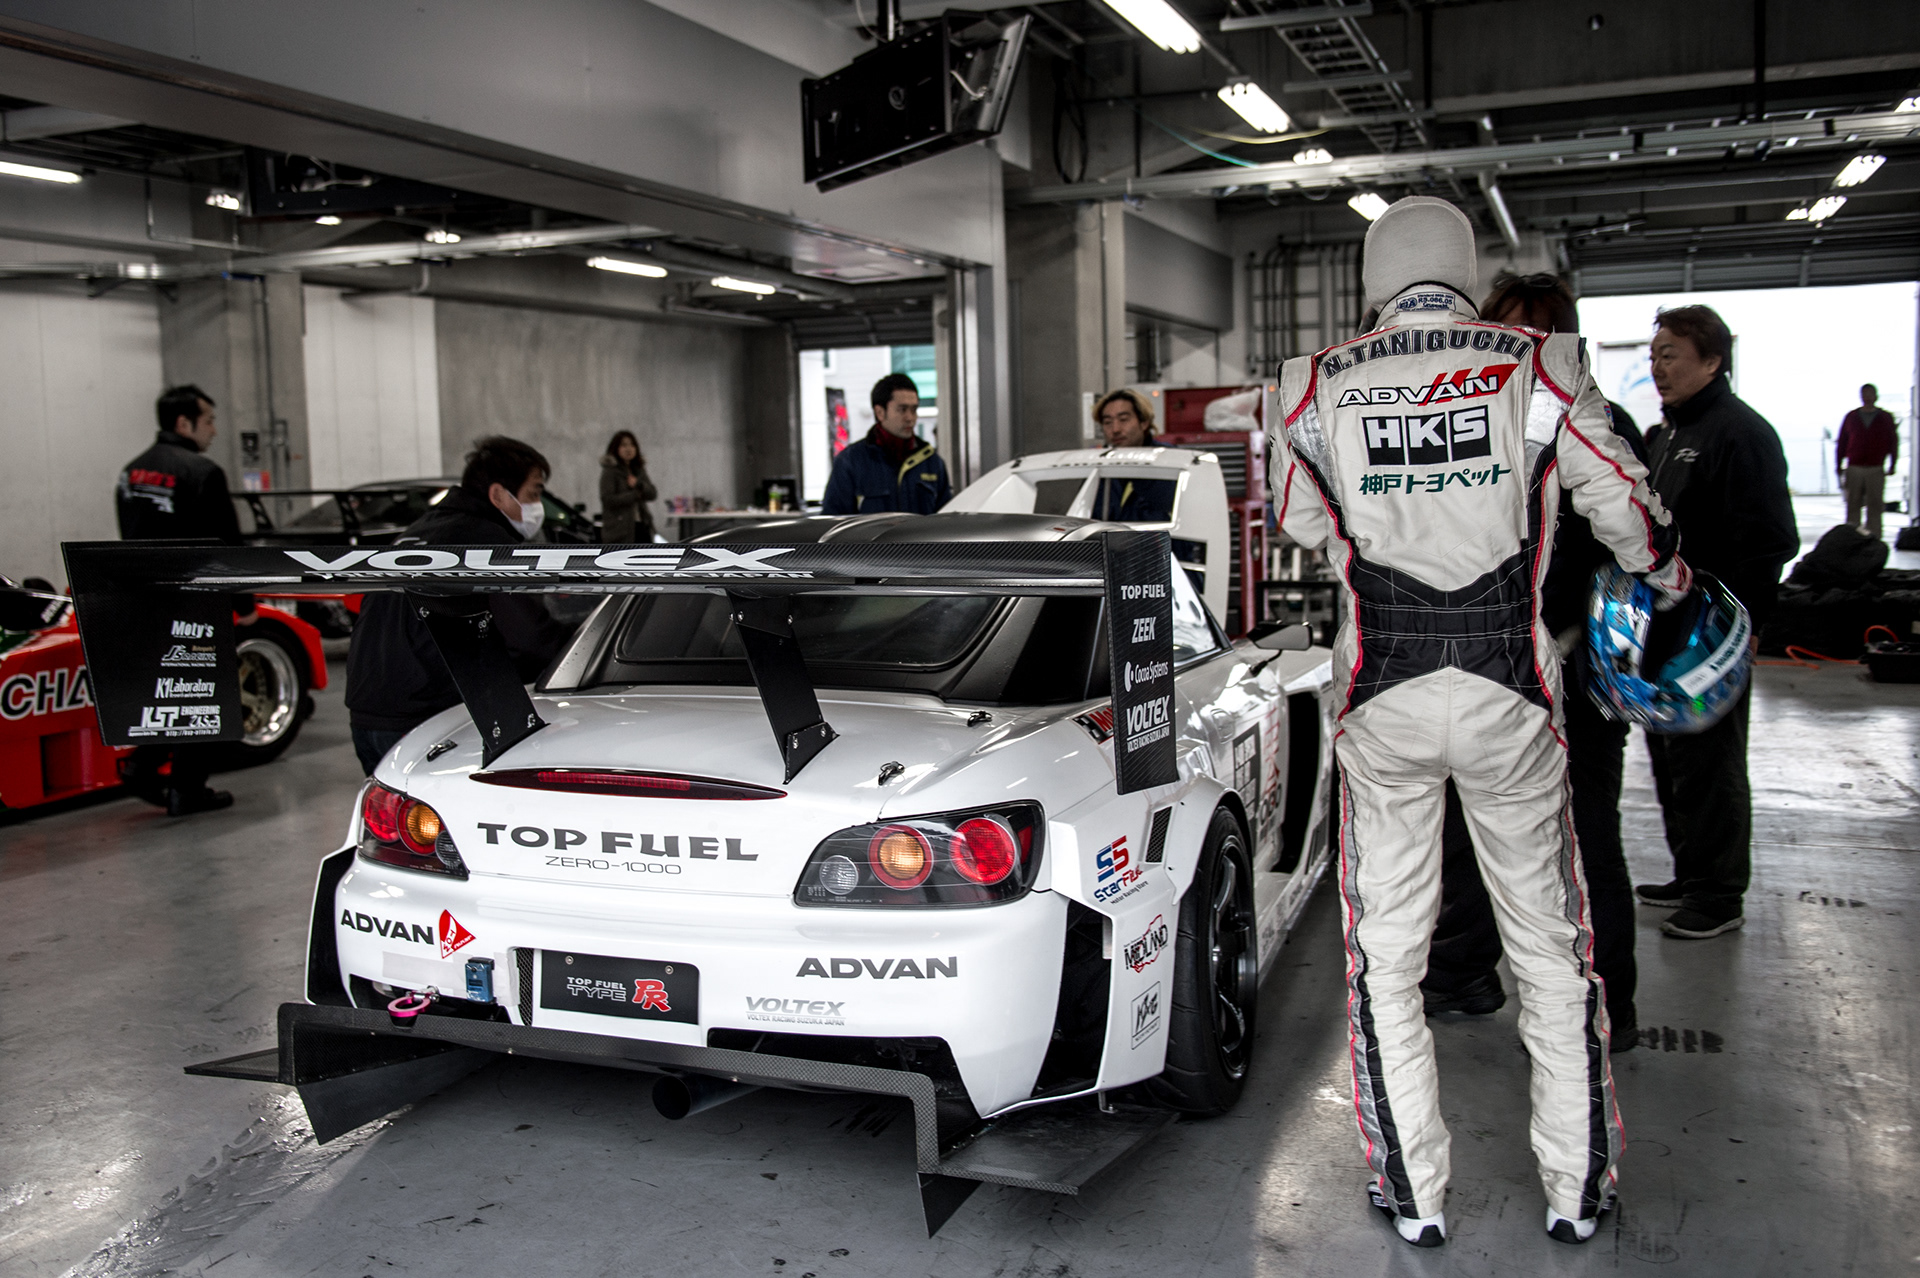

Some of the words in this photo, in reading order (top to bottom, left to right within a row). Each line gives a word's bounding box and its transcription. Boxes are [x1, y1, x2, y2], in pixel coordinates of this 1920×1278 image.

[1336, 374, 1499, 408] ADVAN
[1364, 407, 1488, 451] HKS
[1359, 463, 1511, 495] 神戸トヨペット
[283, 548, 796, 571] VOLTEX
[312, 571, 430, 579] VOLTEX
[1121, 584, 1142, 600] TOP
[1142, 584, 1166, 599] FUEL
[171, 620, 214, 639] Moty's
[1131, 616, 1157, 644] ZEEK
[1126, 695, 1170, 735] VOLTEX
[477, 822, 587, 850] TOP
[601, 831, 759, 861] FUEL
[545, 855, 682, 875] ZERO-1000
[341, 909, 435, 945] ADVAN
[796, 956, 958, 979] ADVAN
[567, 976, 592, 985] TOP
[595, 980, 627, 990] FUEL
[567, 984, 627, 1002] TYPE
[746, 996, 845, 1016] VOLTEX
[747, 1014, 771, 1022] VOLTEX
[772, 1015, 796, 1023] RACING
[797, 1017, 823, 1025] SUZUKA
[824, 1018, 845, 1026] JAPAN
